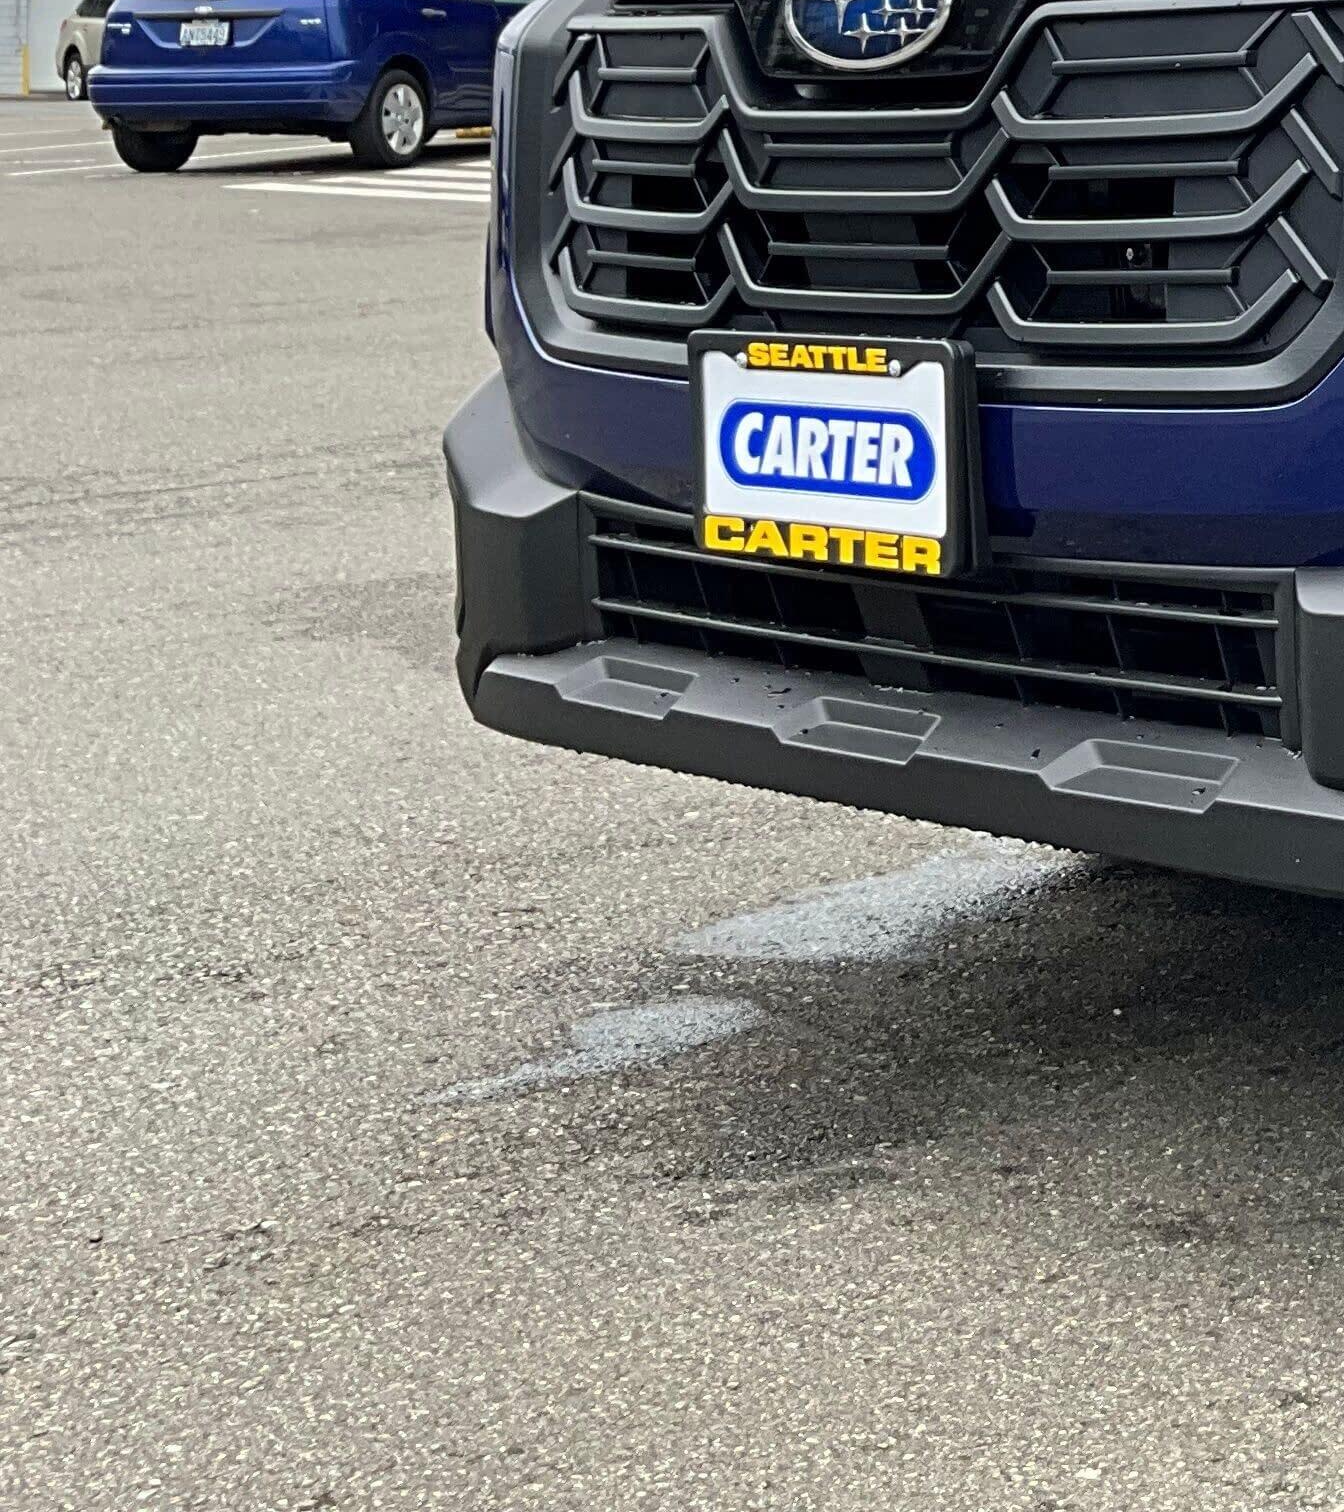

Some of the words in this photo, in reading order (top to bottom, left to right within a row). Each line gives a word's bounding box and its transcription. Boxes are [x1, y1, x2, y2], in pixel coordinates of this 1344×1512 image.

[747, 342, 888, 373] SEATTLE
[733, 411, 913, 488] CARTER
[704, 515, 942, 575] CARTER
